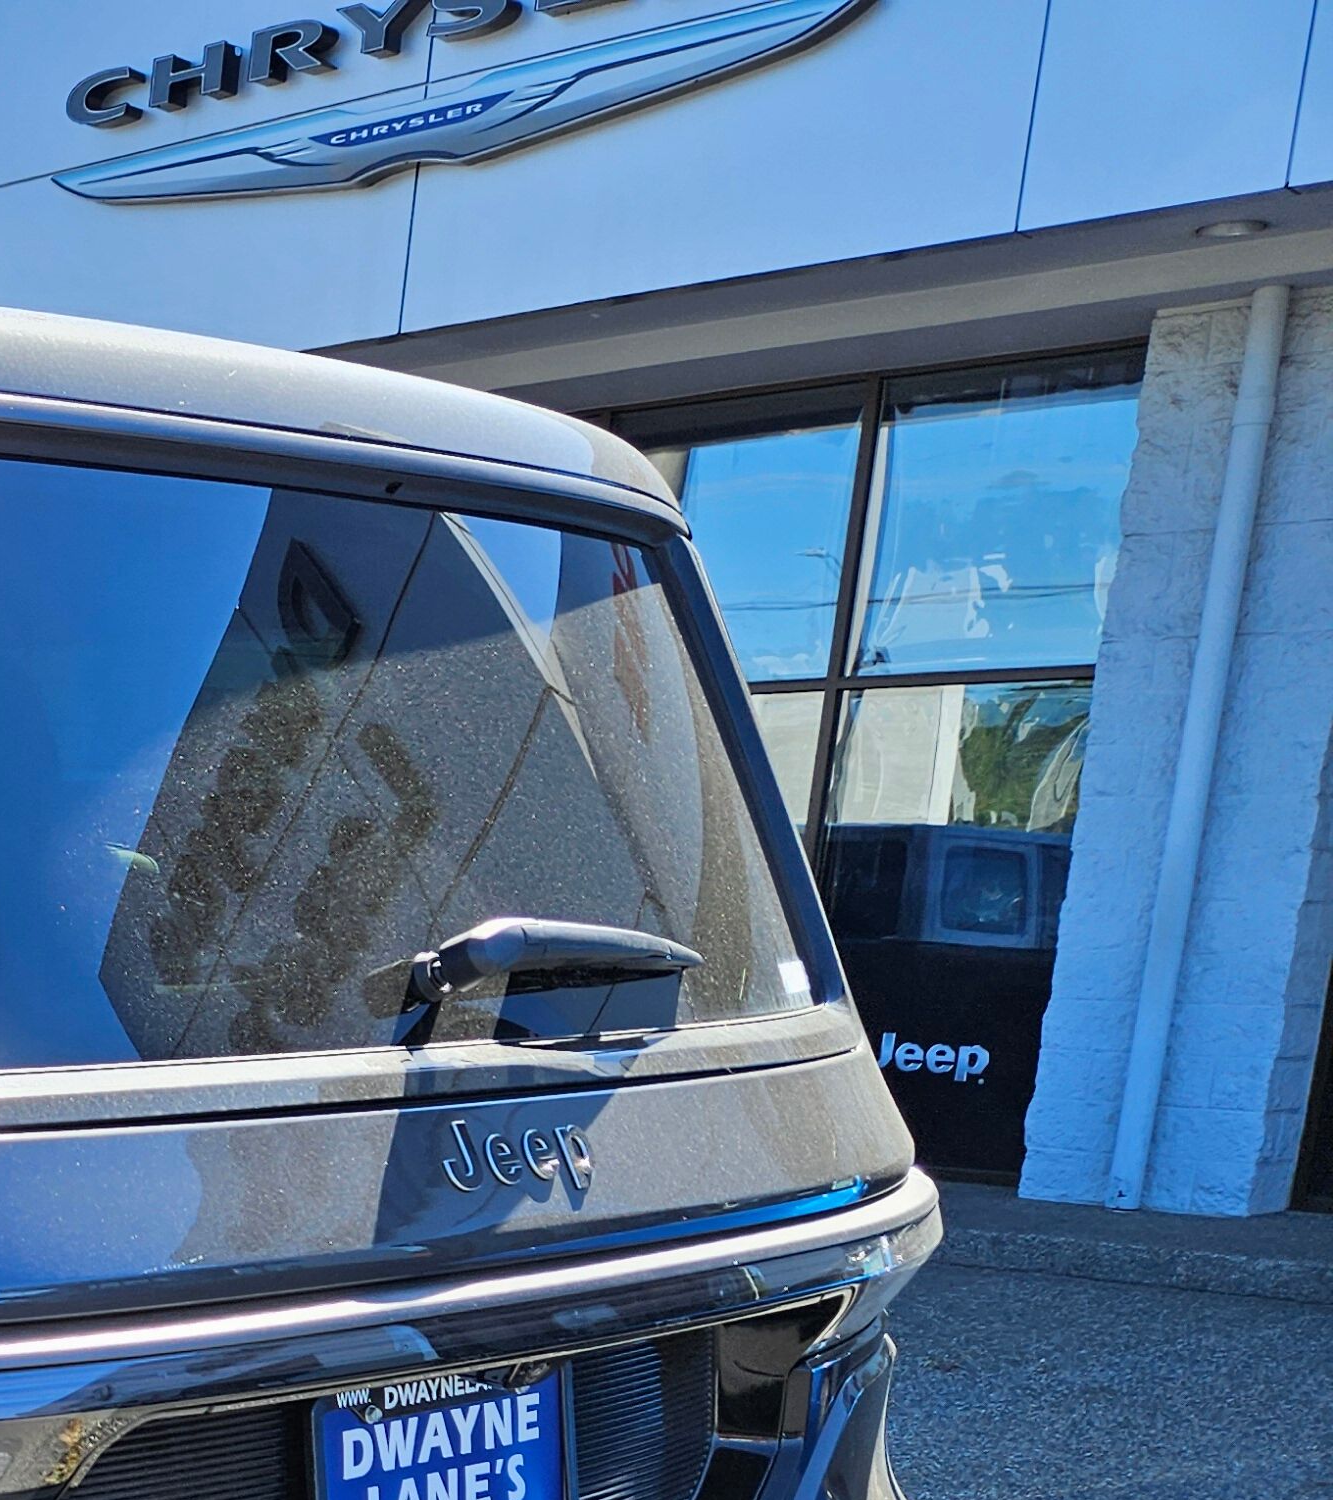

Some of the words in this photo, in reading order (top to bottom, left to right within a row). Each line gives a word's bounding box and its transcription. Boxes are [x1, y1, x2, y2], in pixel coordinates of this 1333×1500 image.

[66, 0, 633, 128] CHRYS
[329, 101, 485, 147] CHRYSLER
[878, 1031, 990, 1083] Jeep
[442, 1118, 592, 1192] Jeep
[341, 1391, 540, 1481] DWAYNE
